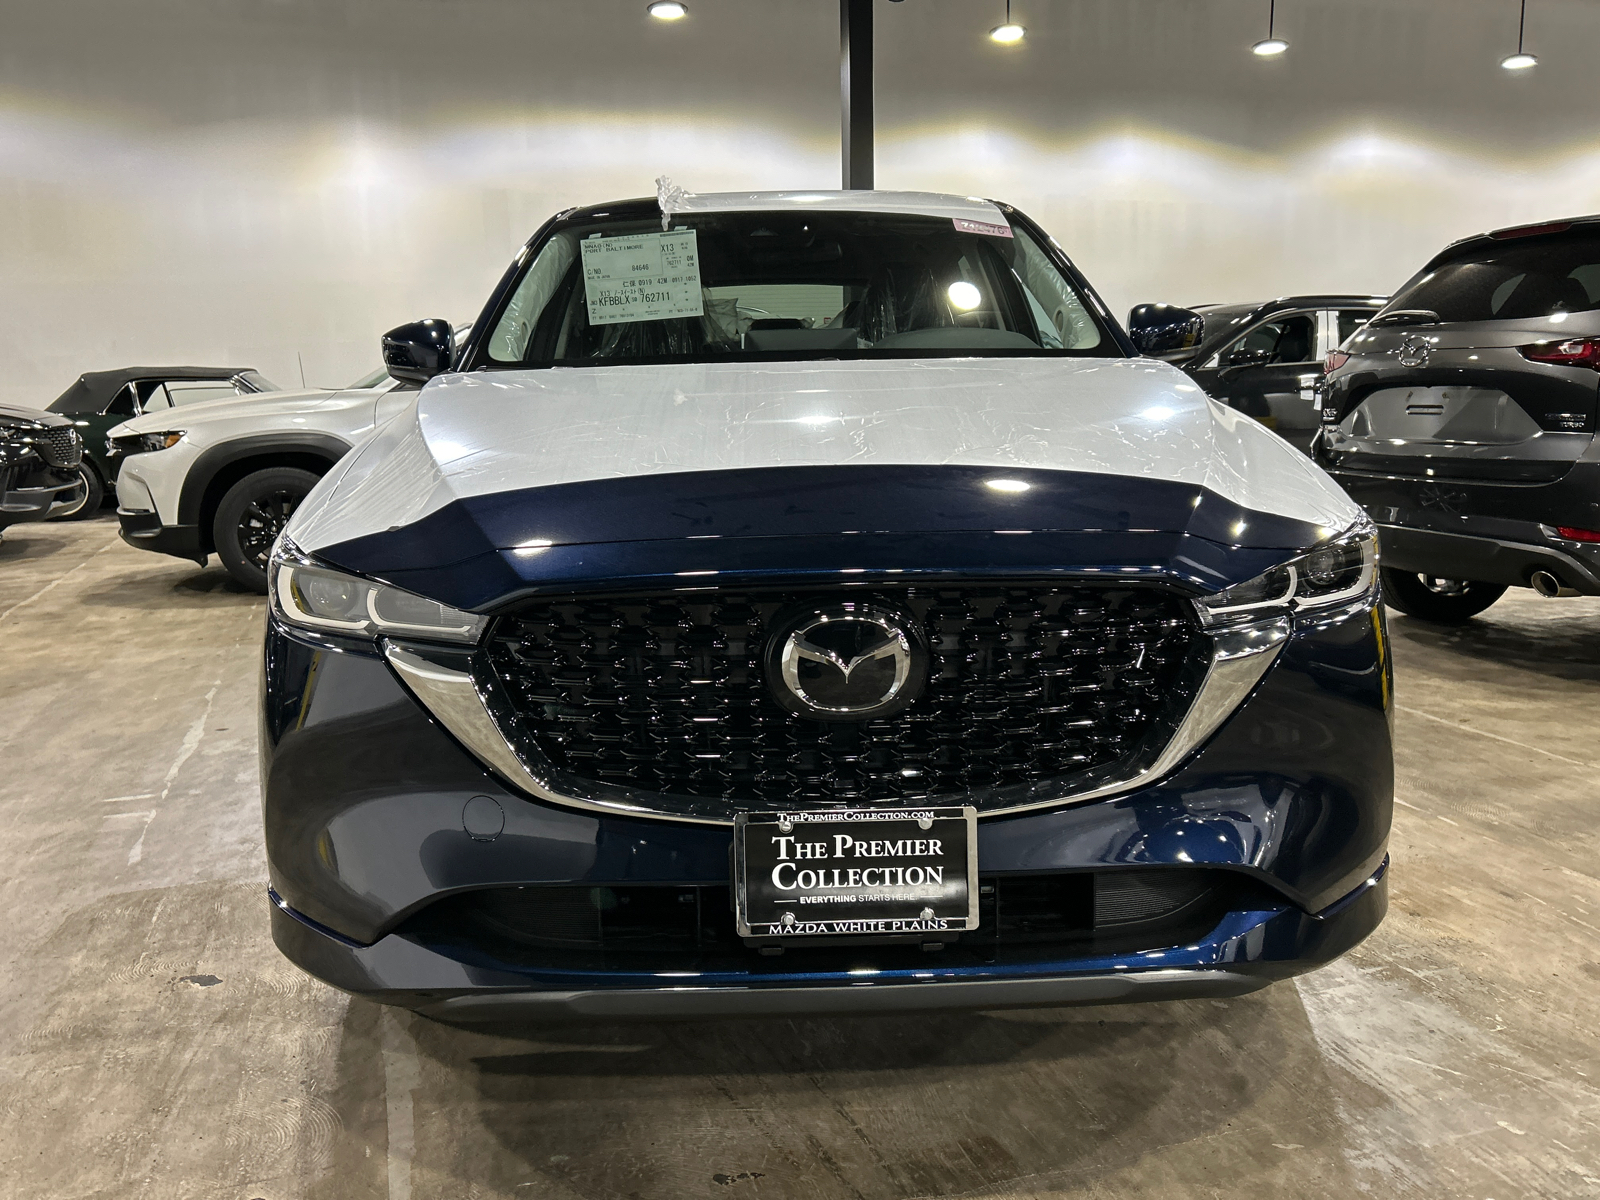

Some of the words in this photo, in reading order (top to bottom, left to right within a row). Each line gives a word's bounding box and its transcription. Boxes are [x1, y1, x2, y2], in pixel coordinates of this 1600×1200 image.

[606, 244, 644, 252] BALTIMORE
[660, 244, 674, 252] X13
[598, 295, 630, 306] KFBBLX
[640, 292, 670, 303] 762711
[771, 835, 828, 860] THE
[832, 834, 944, 858] PREMIER
[772, 862, 944, 890] COLLECTION
[800, 895, 857, 904] EVERYTHING
[858, 894, 890, 902] STARTS
[769, 923, 828, 935] MAZDA
[834, 921, 886, 933] WHITE
[892, 919, 948, 931] PLAINS
